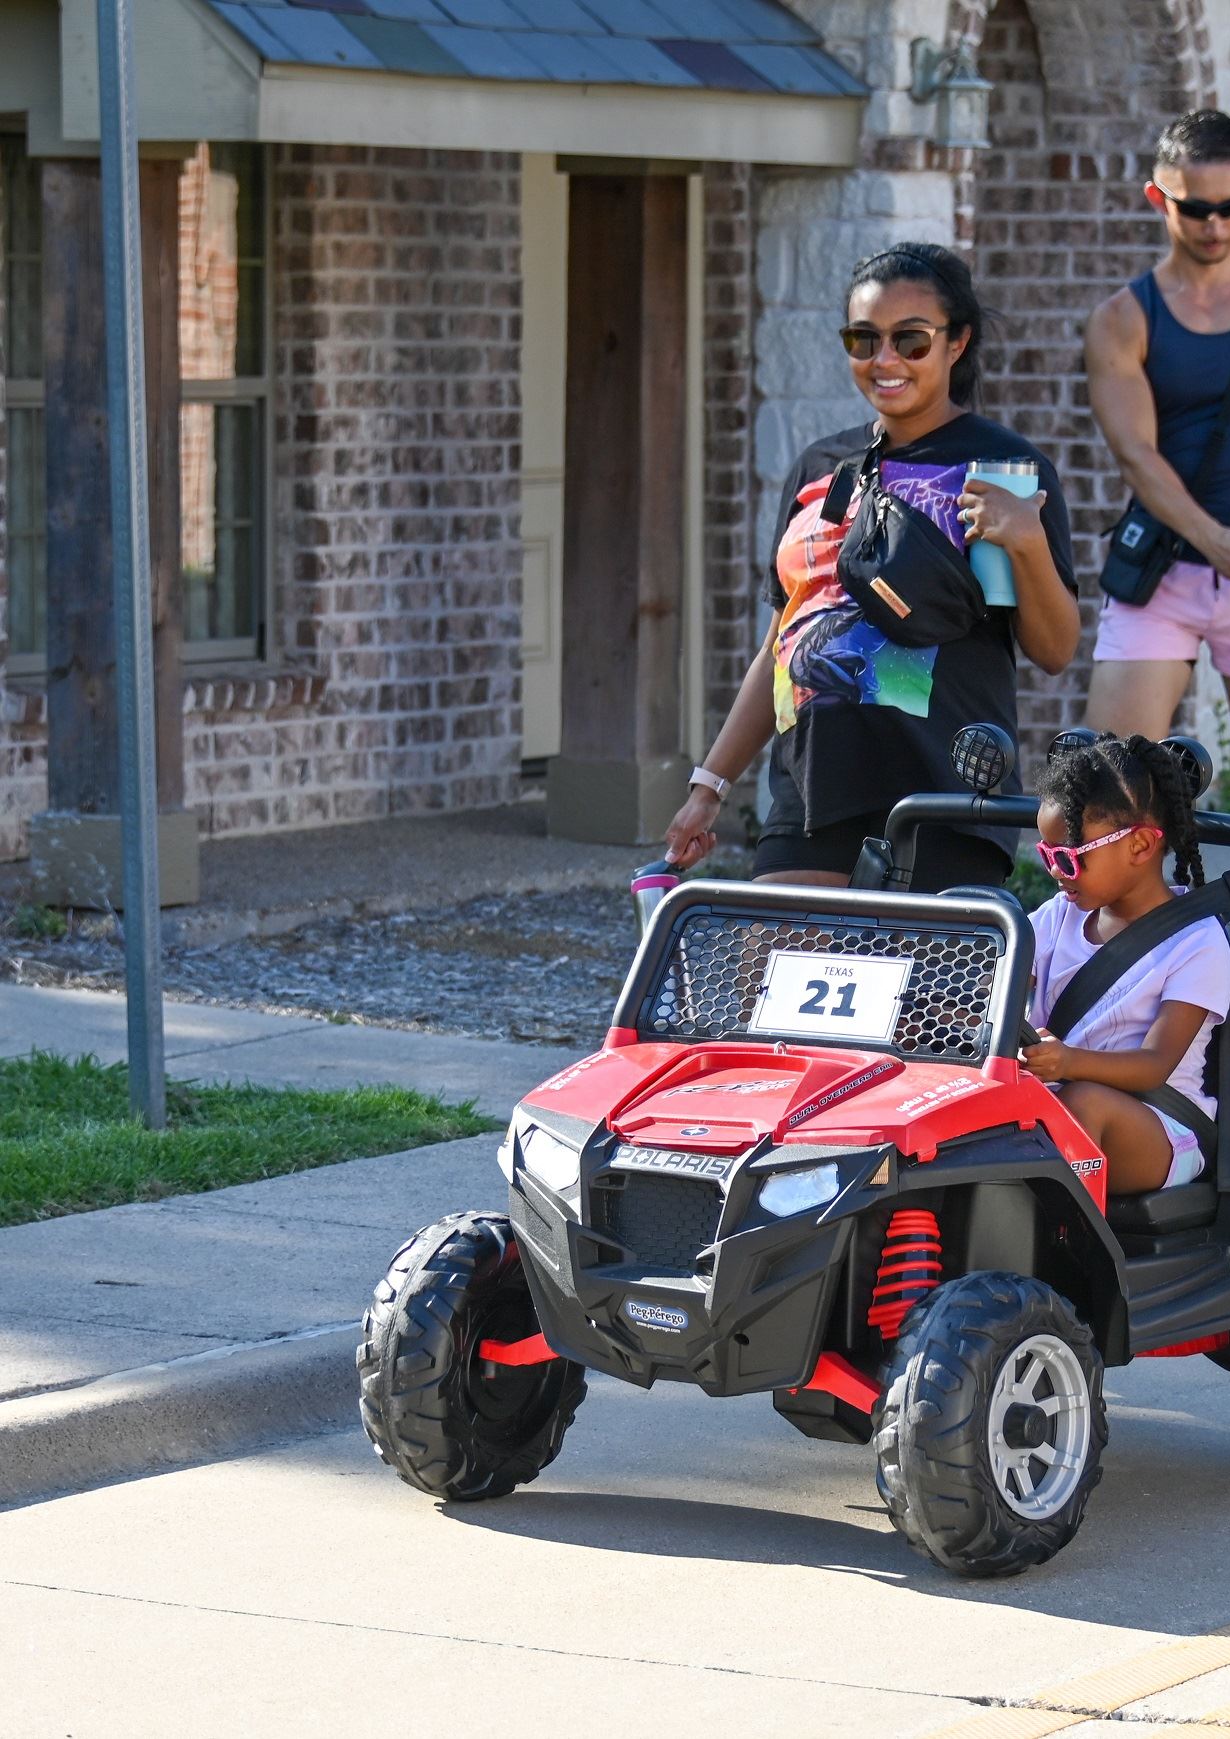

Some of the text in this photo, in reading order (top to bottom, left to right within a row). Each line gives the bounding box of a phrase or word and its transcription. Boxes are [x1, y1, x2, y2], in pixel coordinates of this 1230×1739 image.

[824, 966, 854, 977] TEXAS
[798, 979, 857, 1018] 21
[789, 1104, 819, 1126] DUAL
[819, 1072, 873, 1106] OVERHEAD
[618, 1147, 731, 1175] POLARIS
[1071, 1158, 1103, 1172] 900
